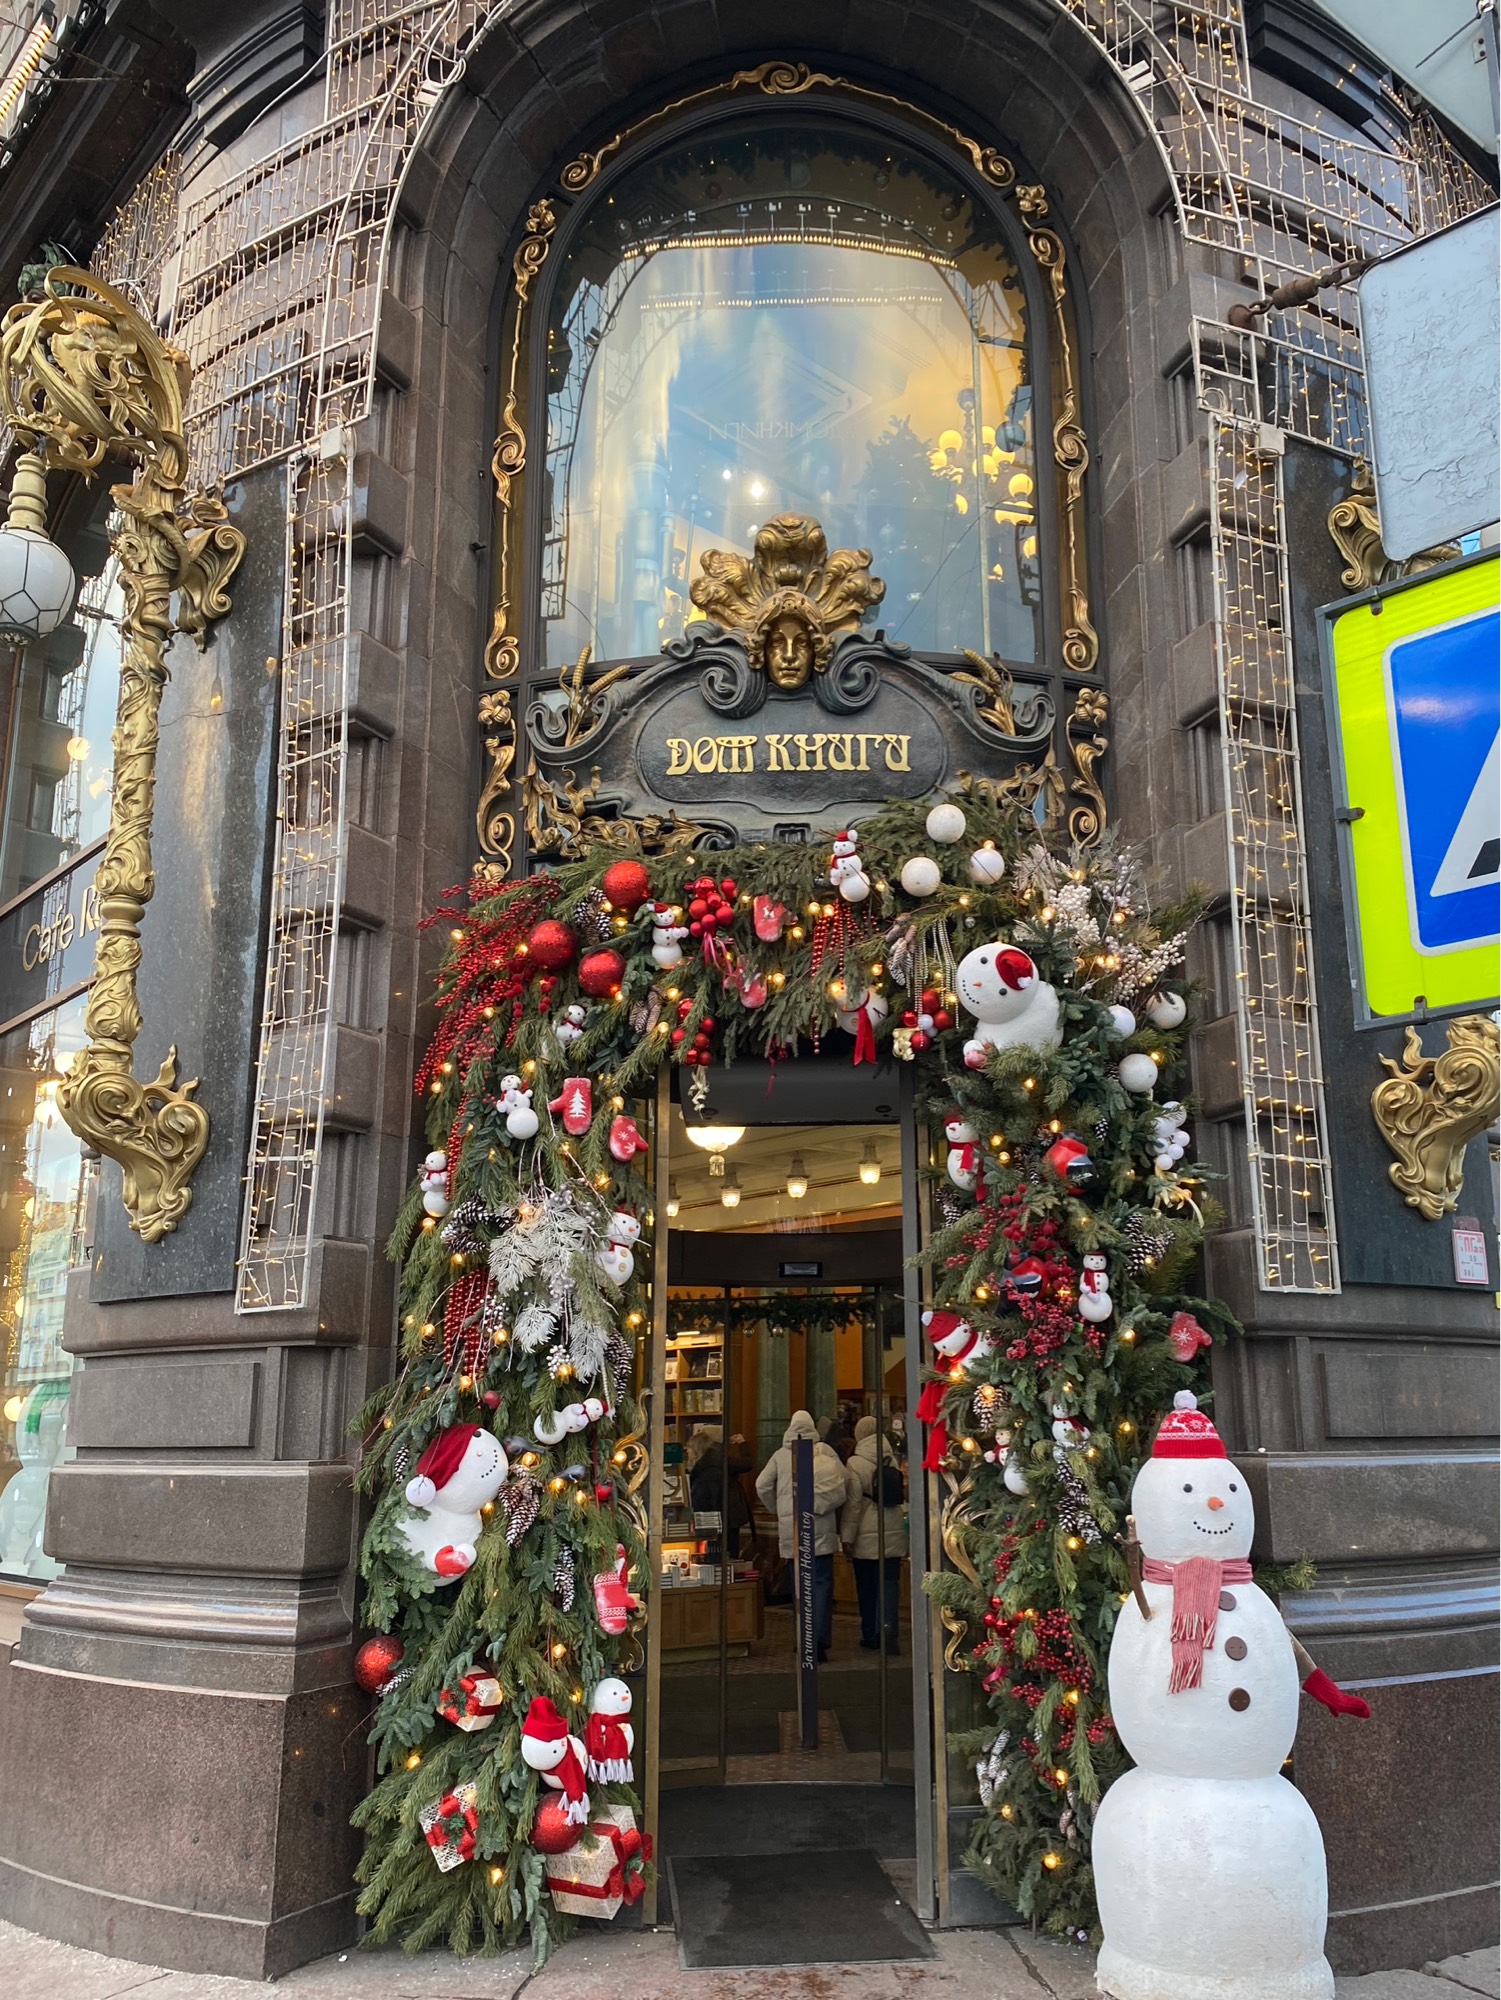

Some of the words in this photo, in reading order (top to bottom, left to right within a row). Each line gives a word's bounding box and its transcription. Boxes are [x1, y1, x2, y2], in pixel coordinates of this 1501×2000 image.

[666, 736, 758, 776] ДОМ
[764, 733, 912, 772] КНИГИ
[23, 904, 75, 971] Cafe
[802, 1511, 815, 1529] год
